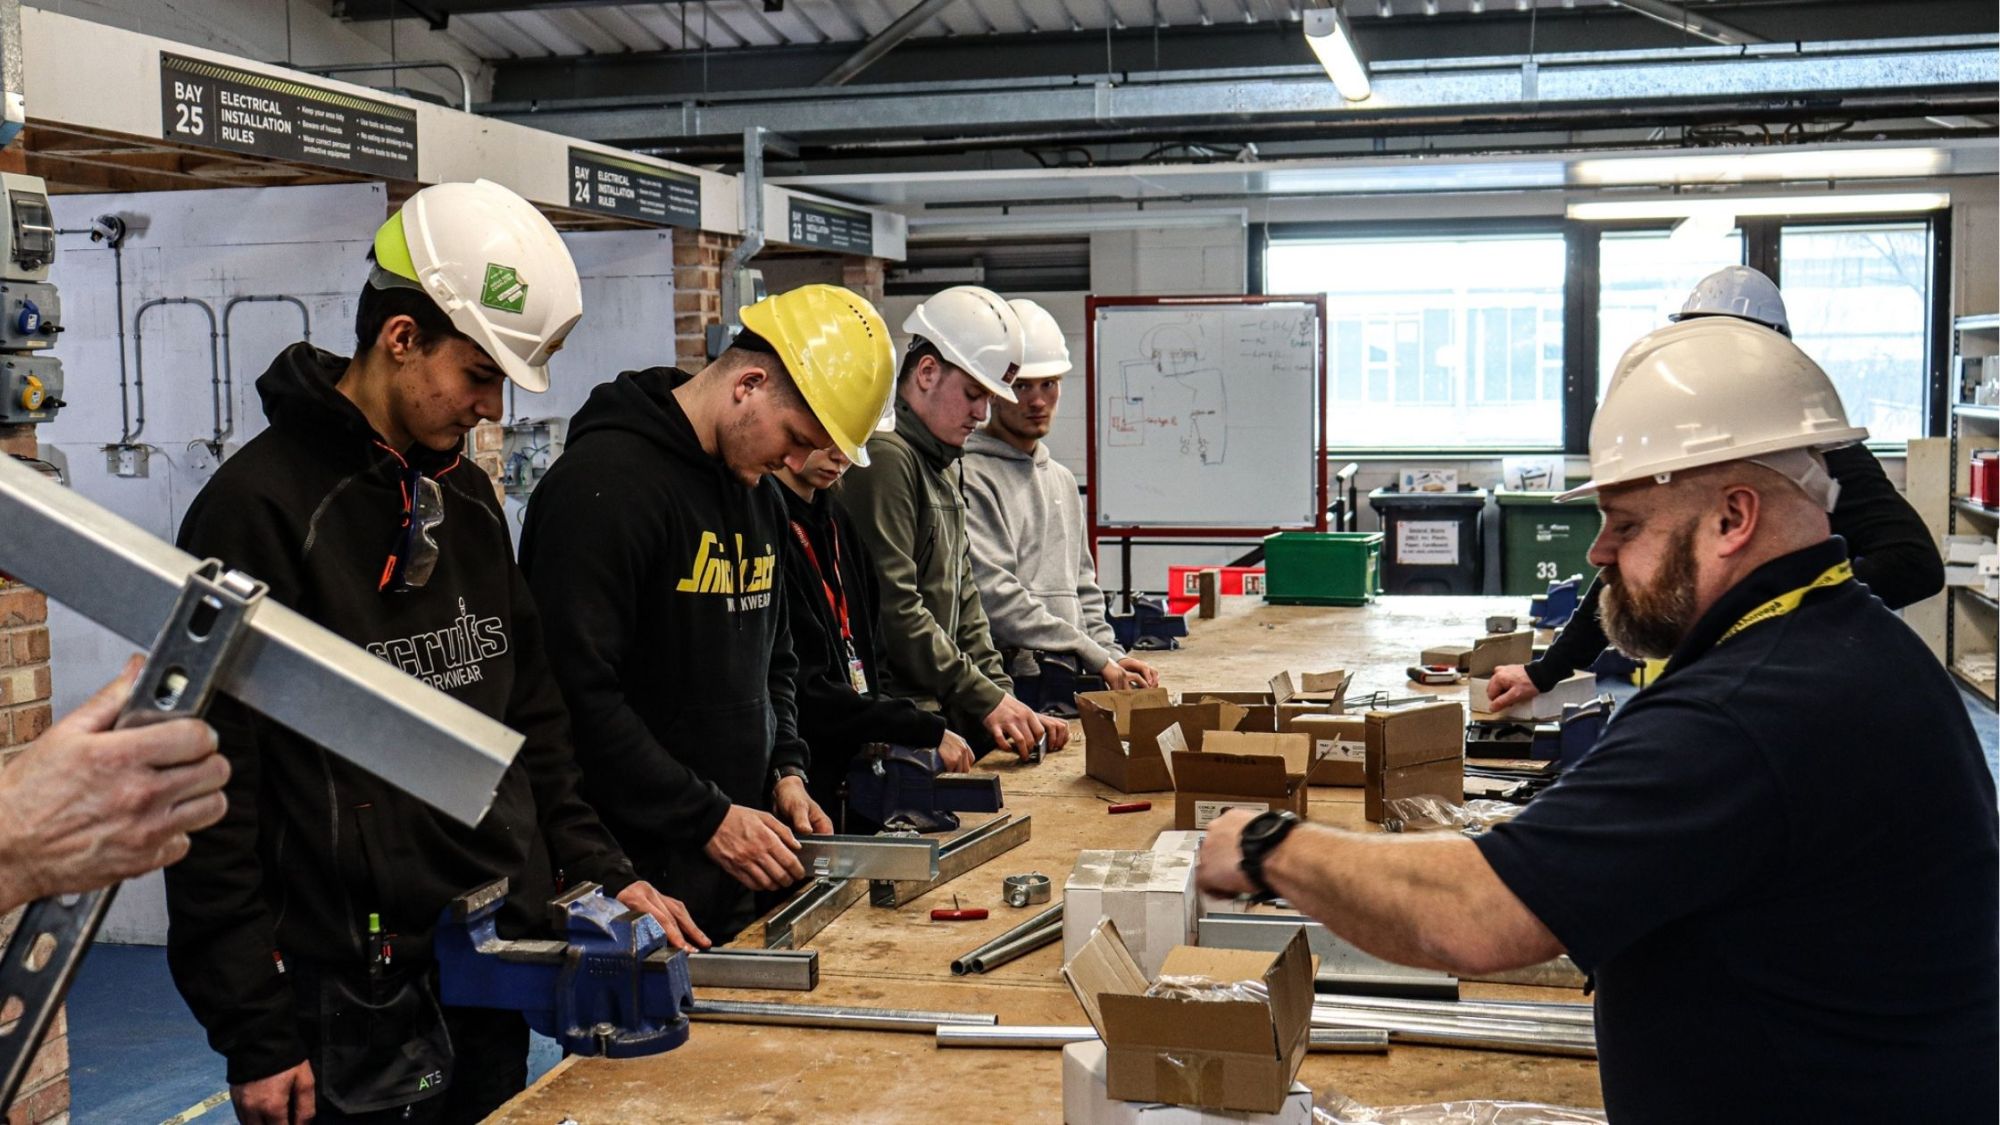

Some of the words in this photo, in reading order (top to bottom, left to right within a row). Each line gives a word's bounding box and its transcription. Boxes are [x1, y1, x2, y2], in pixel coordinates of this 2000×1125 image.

[174, 81, 203, 102] BAY
[220, 91, 282, 115] ELECTRICAL
[175, 104, 204, 136] 25
[221, 109, 292, 134] INSTALLATION
[221, 125, 255, 144] RULES
[574, 166, 590, 180] BAY
[597, 170, 630, 186] ELECTRICAL
[575, 181, 591, 204] 24
[598, 183, 635, 199] INSTALLATION
[598, 195, 616, 208] RULES
[1536, 561, 1557, 579] 33
[420, 664, 484, 691] ORKWEAR
